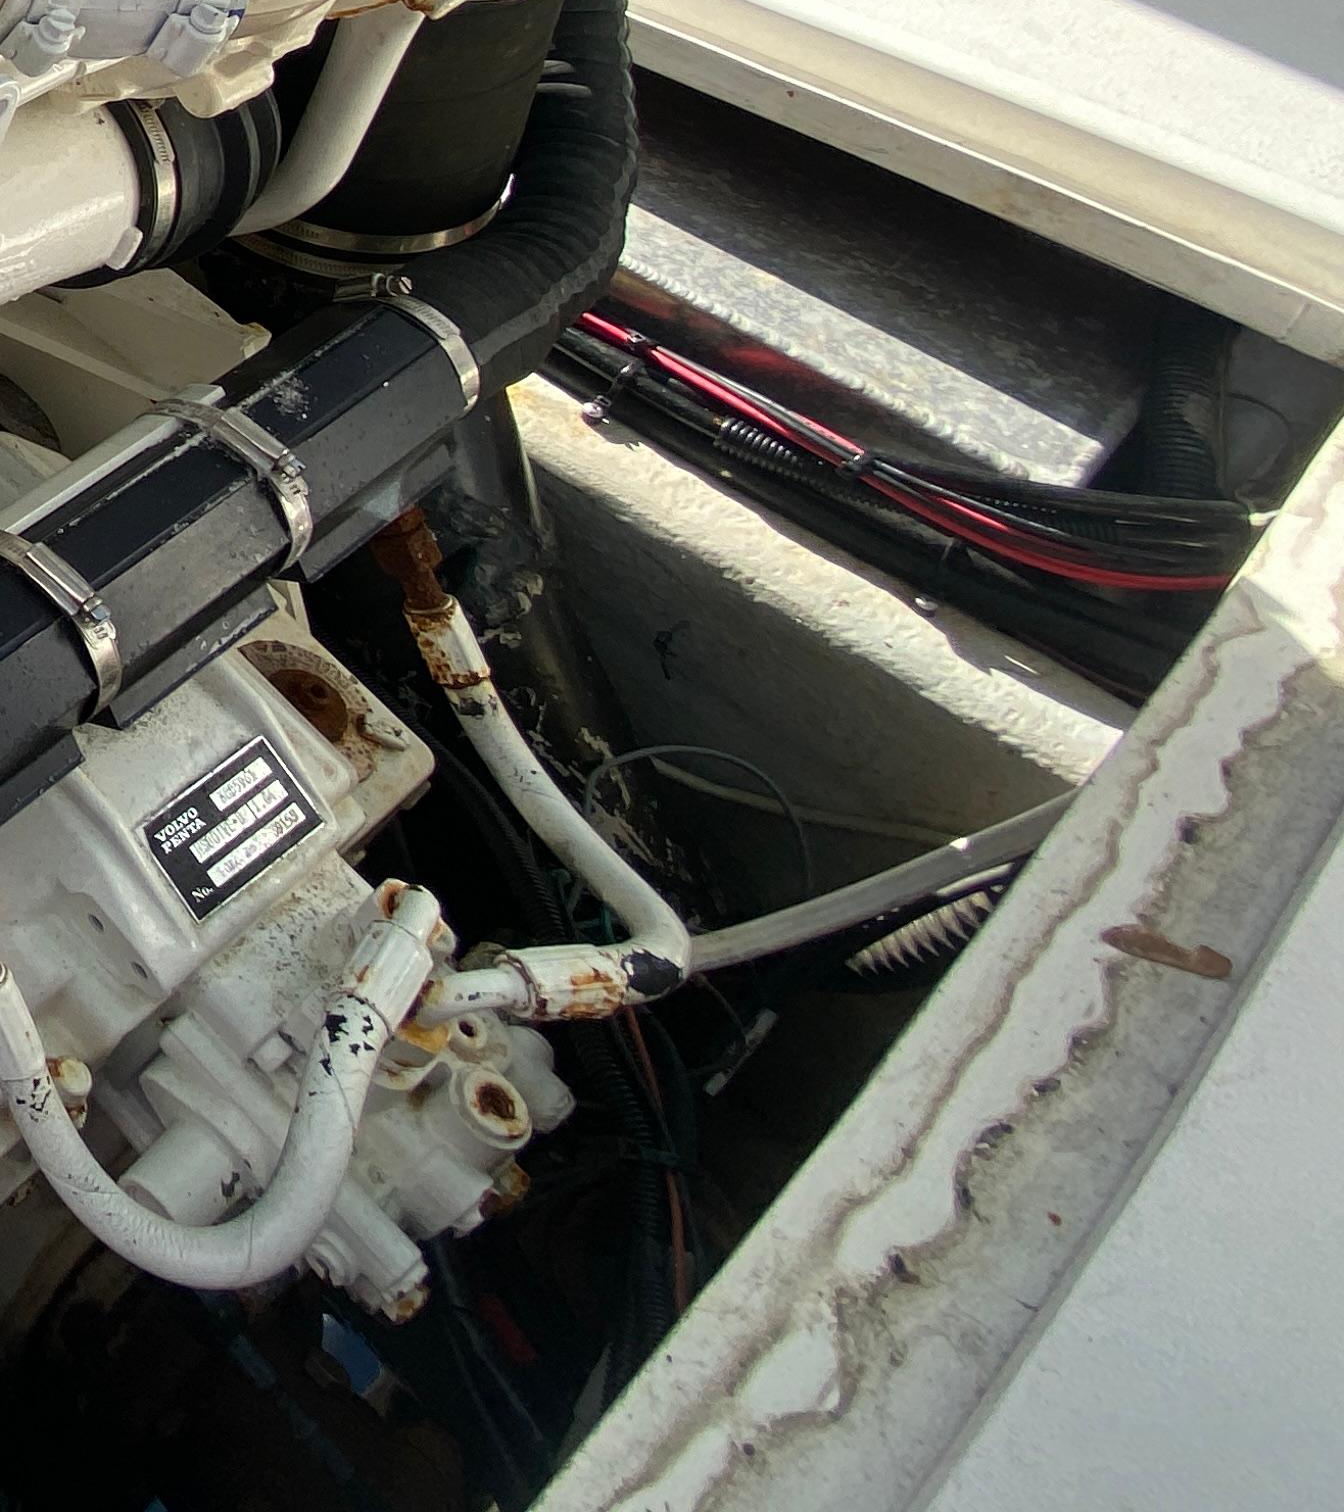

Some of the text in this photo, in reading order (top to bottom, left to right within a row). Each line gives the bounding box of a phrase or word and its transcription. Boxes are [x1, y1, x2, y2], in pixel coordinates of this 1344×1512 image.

[152, 805, 199, 844] VOLVO
[160, 815, 207, 854] PENTA
[190, 880, 214, 903] No.
